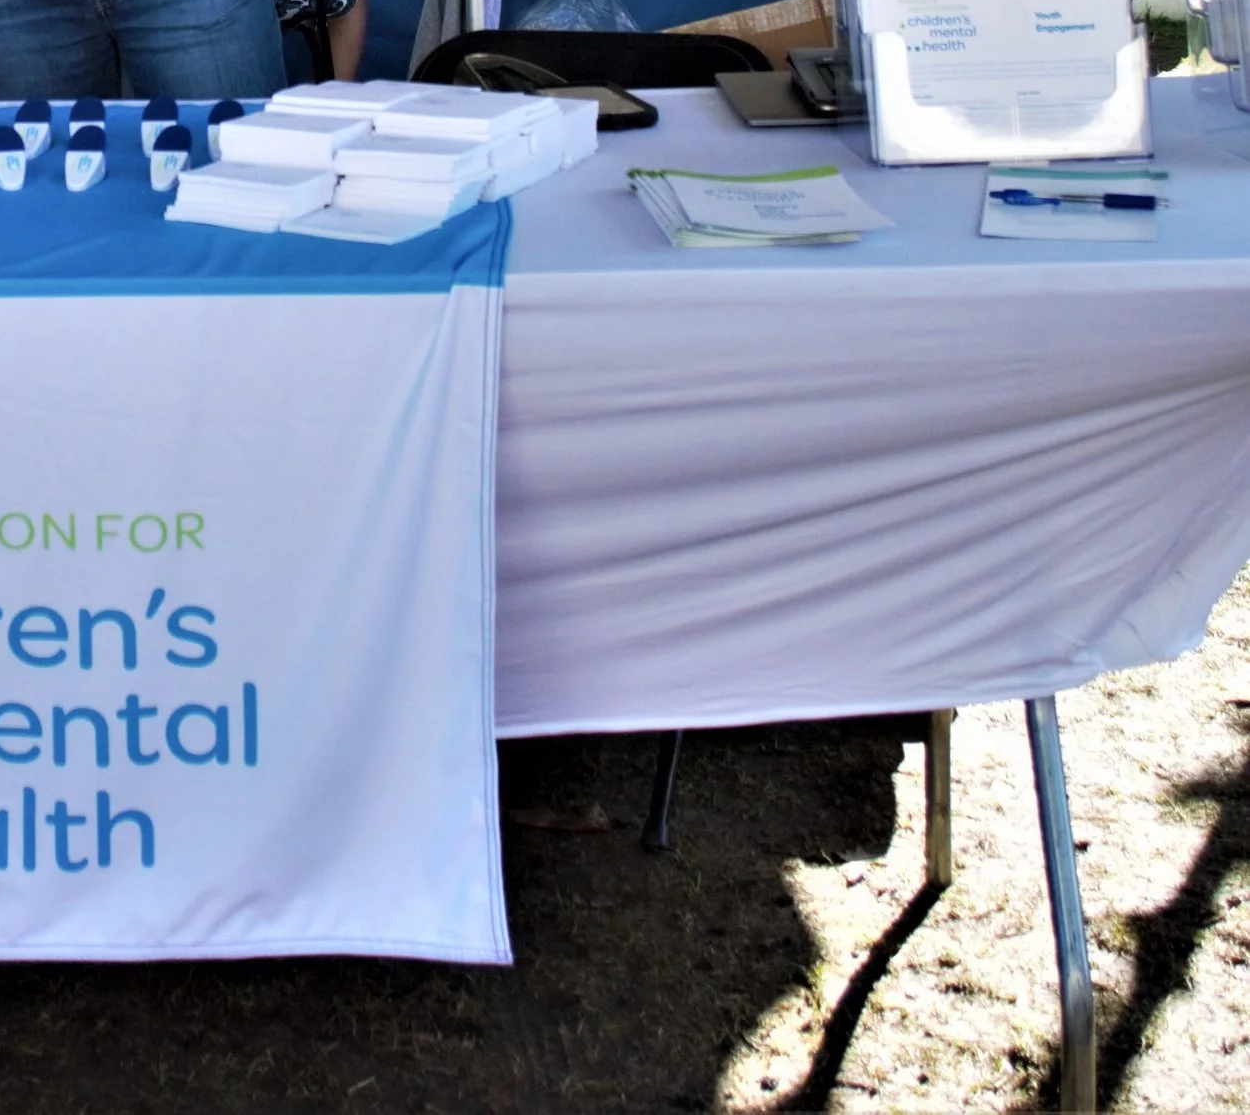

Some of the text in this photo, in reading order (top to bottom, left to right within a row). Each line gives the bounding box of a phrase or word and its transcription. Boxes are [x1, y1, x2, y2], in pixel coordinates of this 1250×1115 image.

[907, 14, 971, 27] children's
[1035, 11, 1062, 20] Youth
[929, 26, 977, 37] mental
[1036, 22, 1095, 32] Engagement
[922, 40, 966, 52] health
[96, 512, 206, 552] FOR
